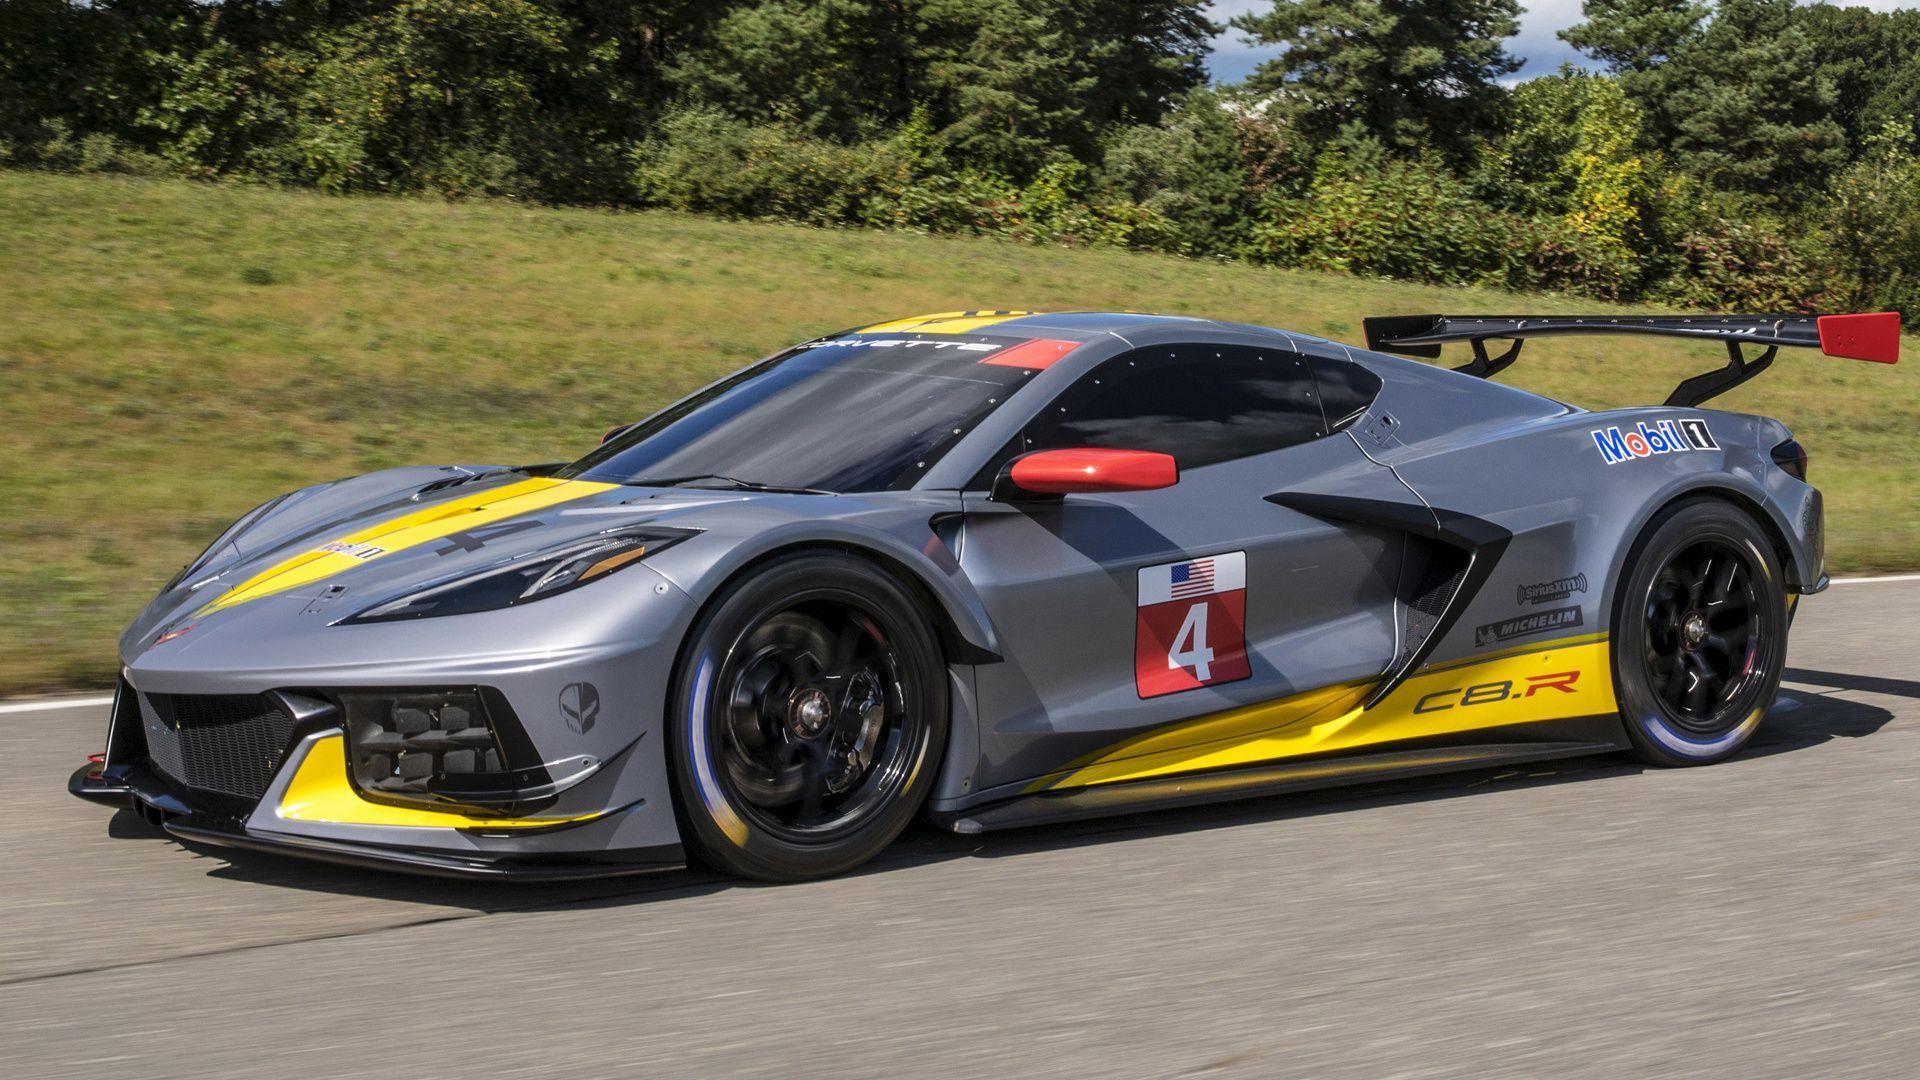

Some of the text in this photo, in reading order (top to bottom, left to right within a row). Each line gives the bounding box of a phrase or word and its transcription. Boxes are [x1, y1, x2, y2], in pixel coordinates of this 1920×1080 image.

[1591, 420, 1690, 464] Mobil
[1168, 602, 1214, 681] 4
[1500, 609, 1577, 636] MICHELIN
[1413, 670, 1581, 715] C8.R
